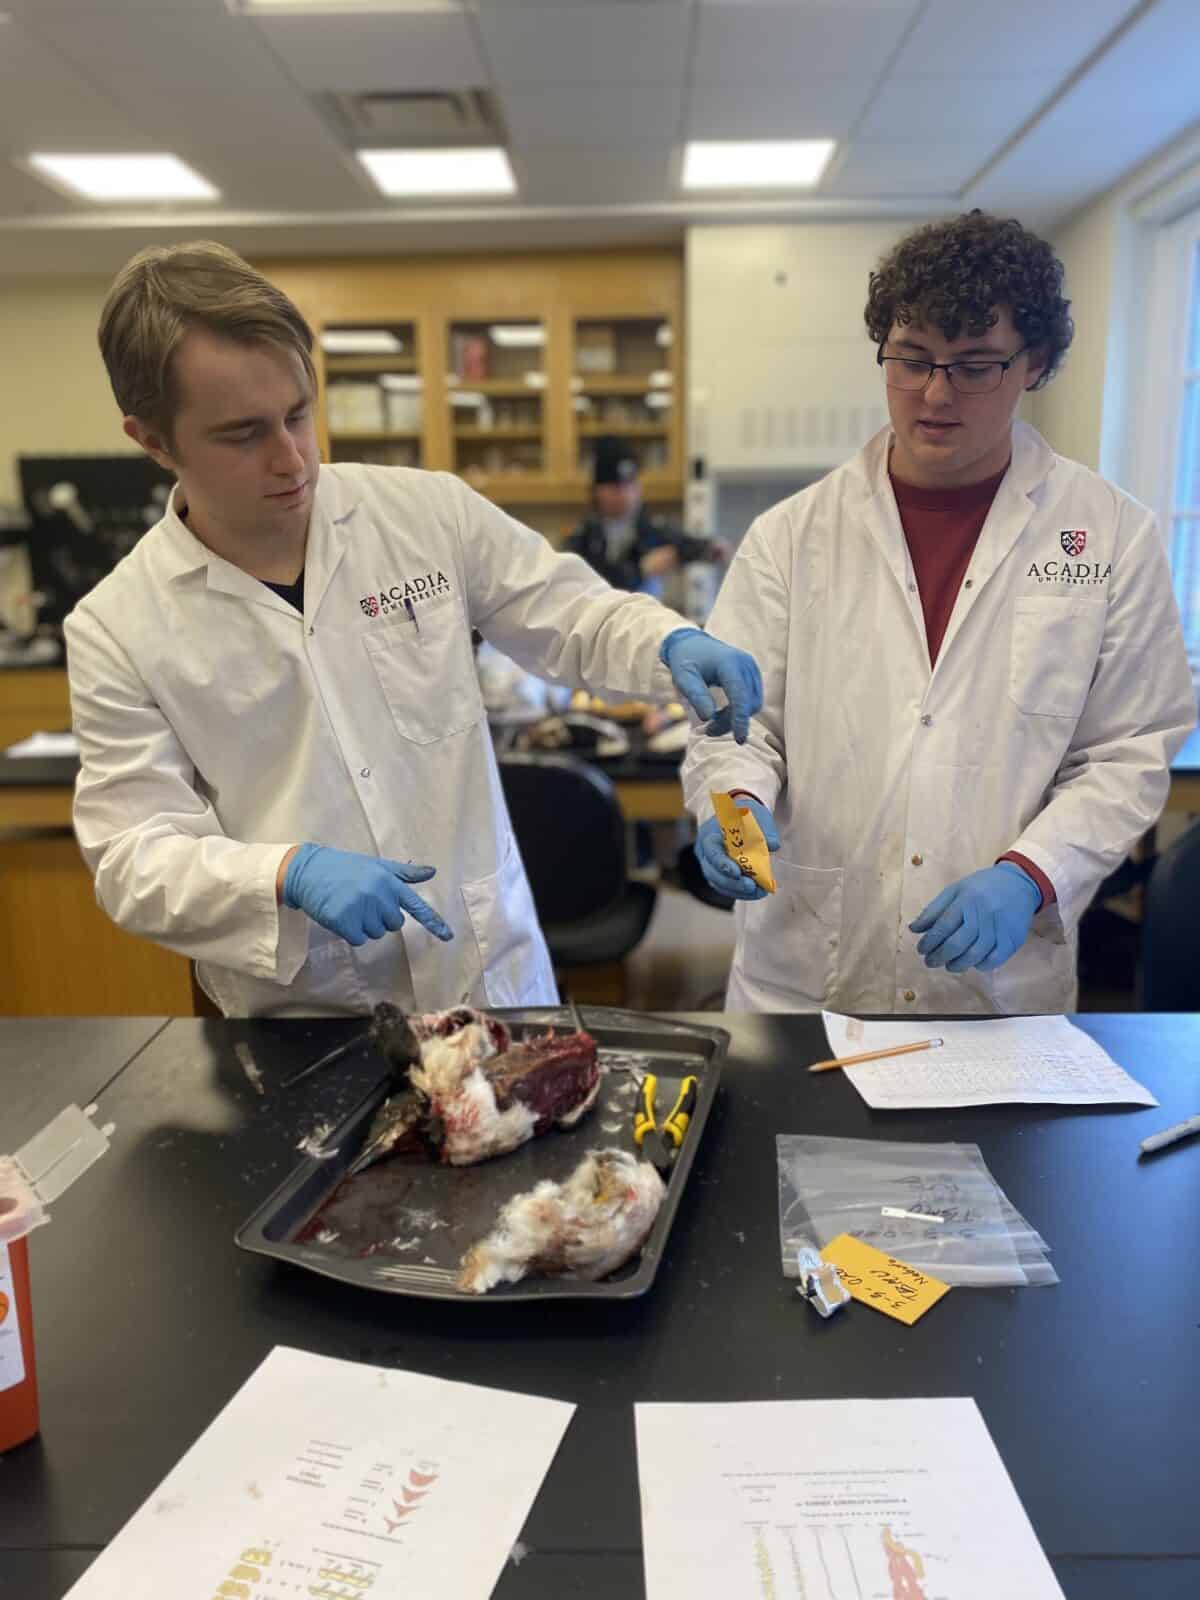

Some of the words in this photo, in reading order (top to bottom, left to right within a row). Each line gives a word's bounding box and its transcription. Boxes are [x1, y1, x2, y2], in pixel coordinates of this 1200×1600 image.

[1027, 561, 1112, 578] ACADIA
[380, 570, 448, 606] ACADIA
[382, 584, 451, 615] UNIERSITY
